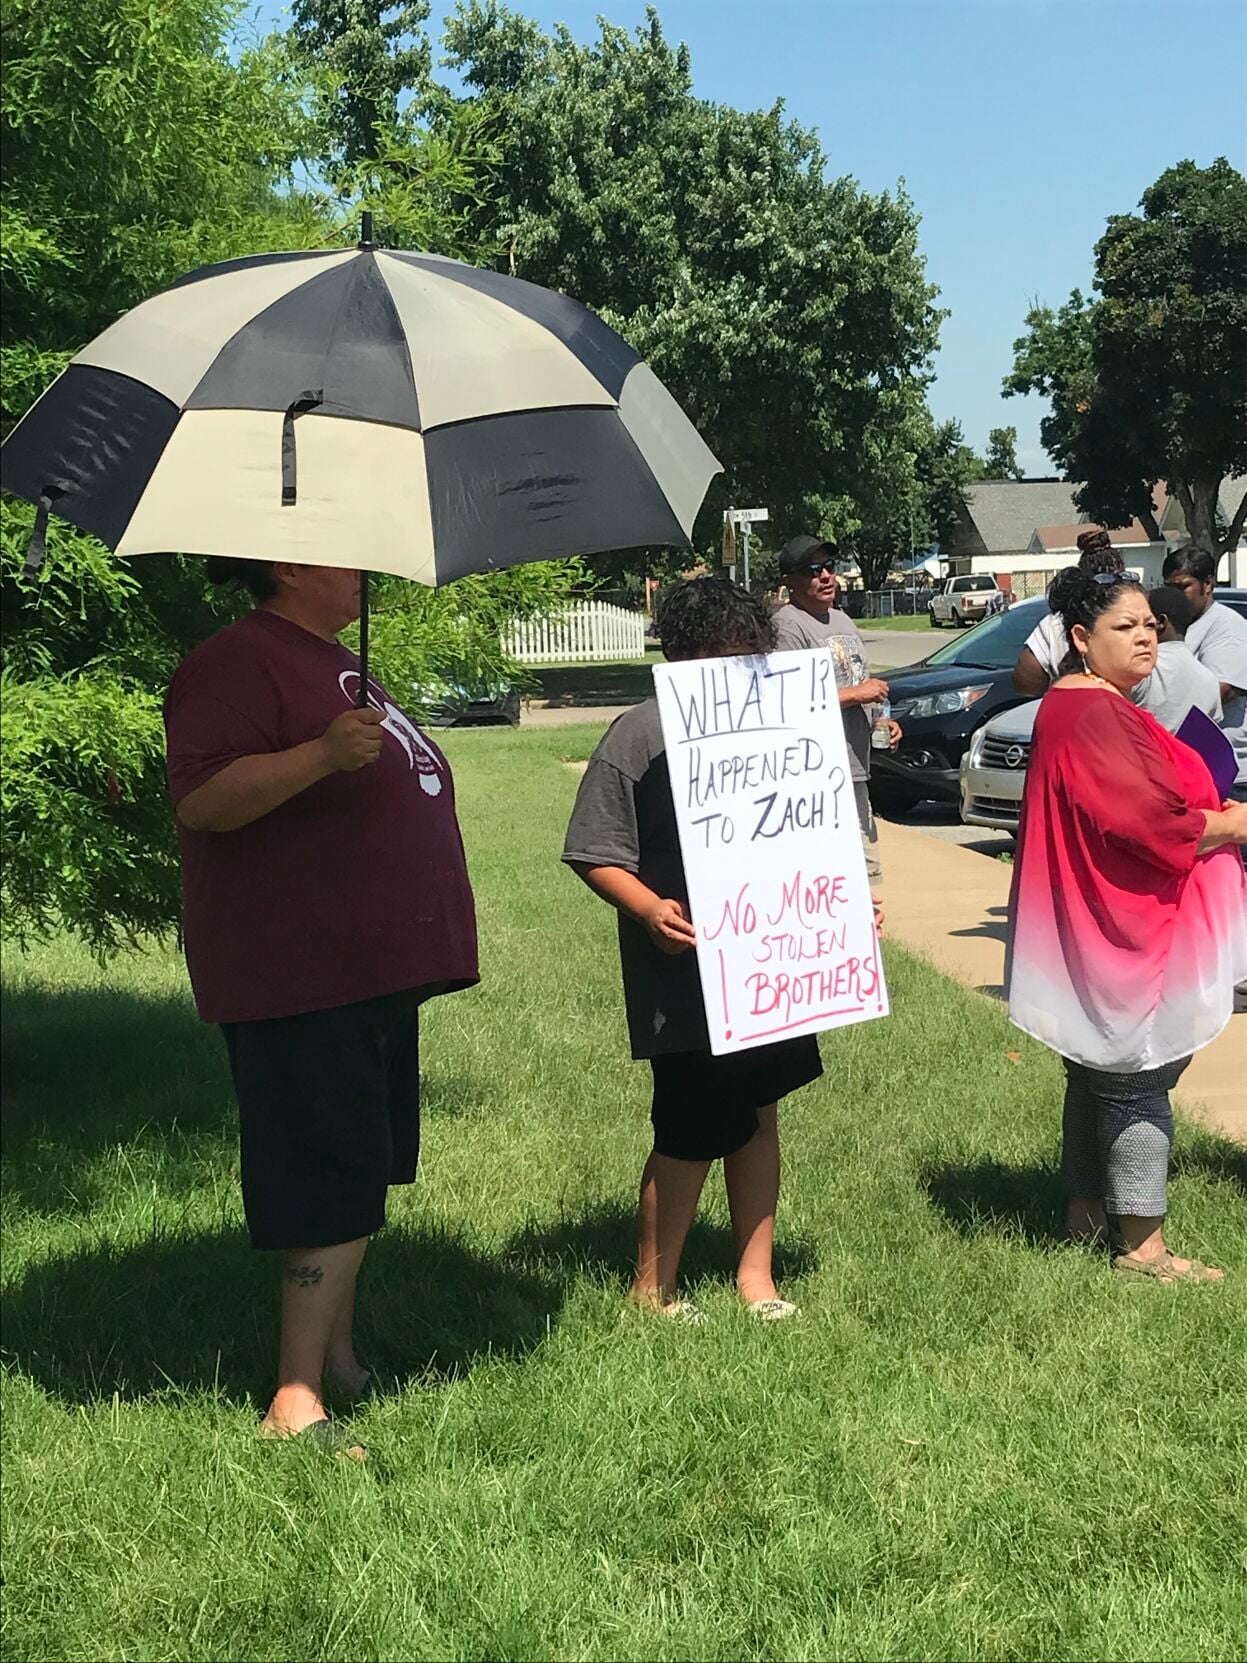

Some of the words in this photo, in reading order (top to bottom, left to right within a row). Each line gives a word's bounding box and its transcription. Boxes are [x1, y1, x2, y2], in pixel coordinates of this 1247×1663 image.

[688, 738, 823, 808] HAPPENED
[691, 814, 735, 849] TO
[751, 766, 845, 841] ZACH?
[703, 883, 757, 941] NO
[766, 871, 849, 929] MORE
[752, 922, 848, 963] STOLEN
